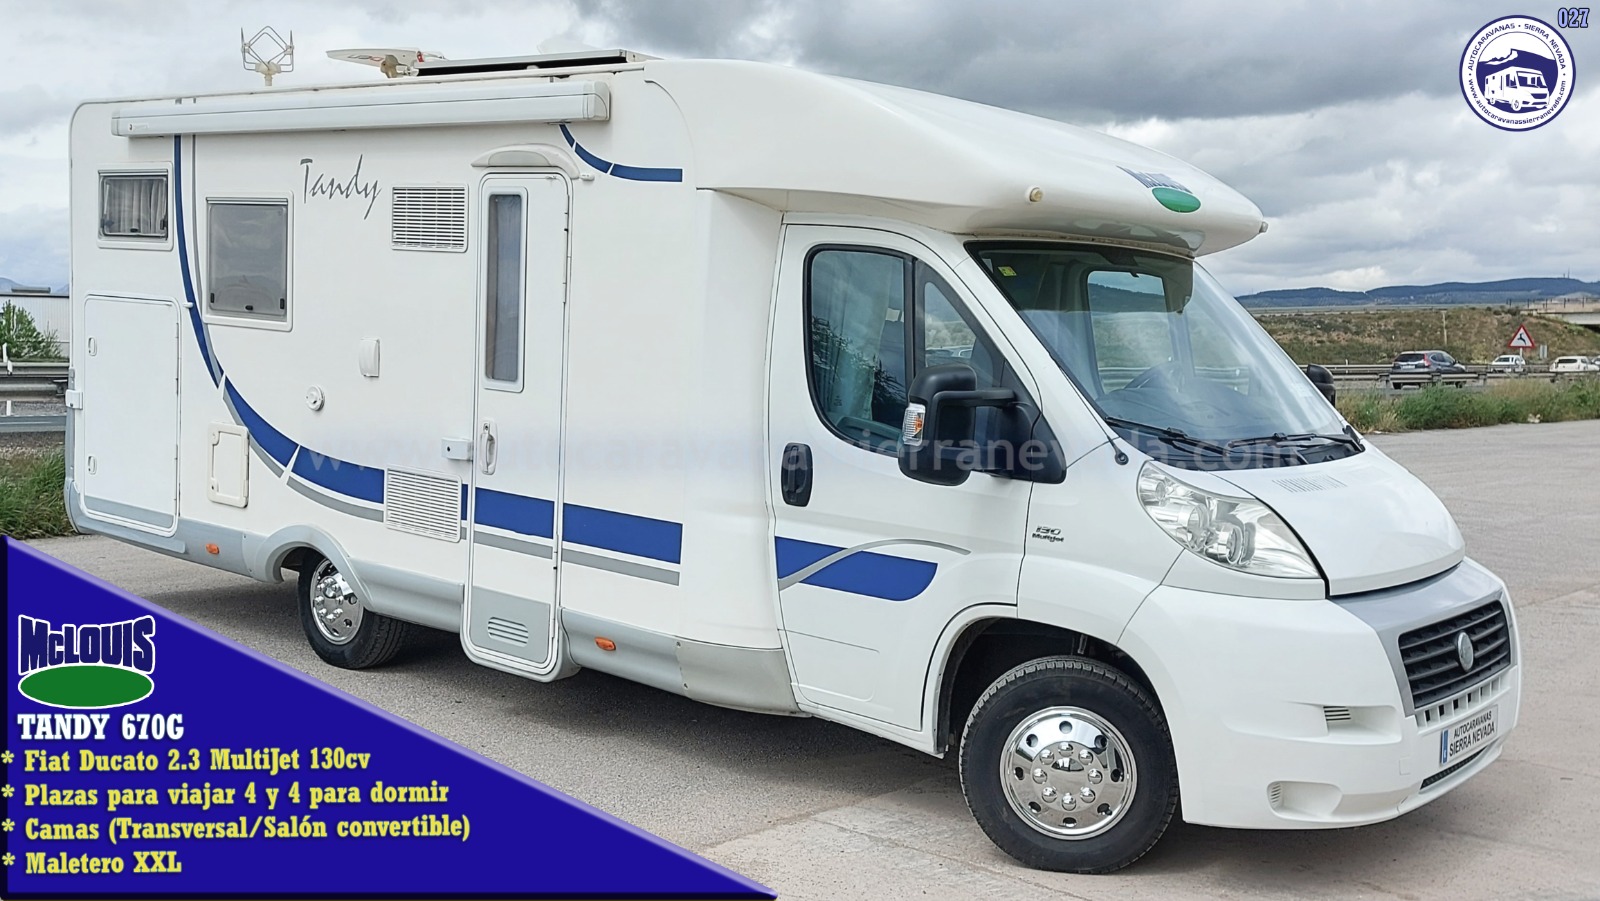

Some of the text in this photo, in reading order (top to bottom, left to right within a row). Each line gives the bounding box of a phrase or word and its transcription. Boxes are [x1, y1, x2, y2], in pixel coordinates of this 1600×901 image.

[300, 153, 382, 220] Tandy
[1449, 721, 1495, 757] SIERRA NEVADA
[1453, 710, 1492, 739] AUTOCARAVANAS
